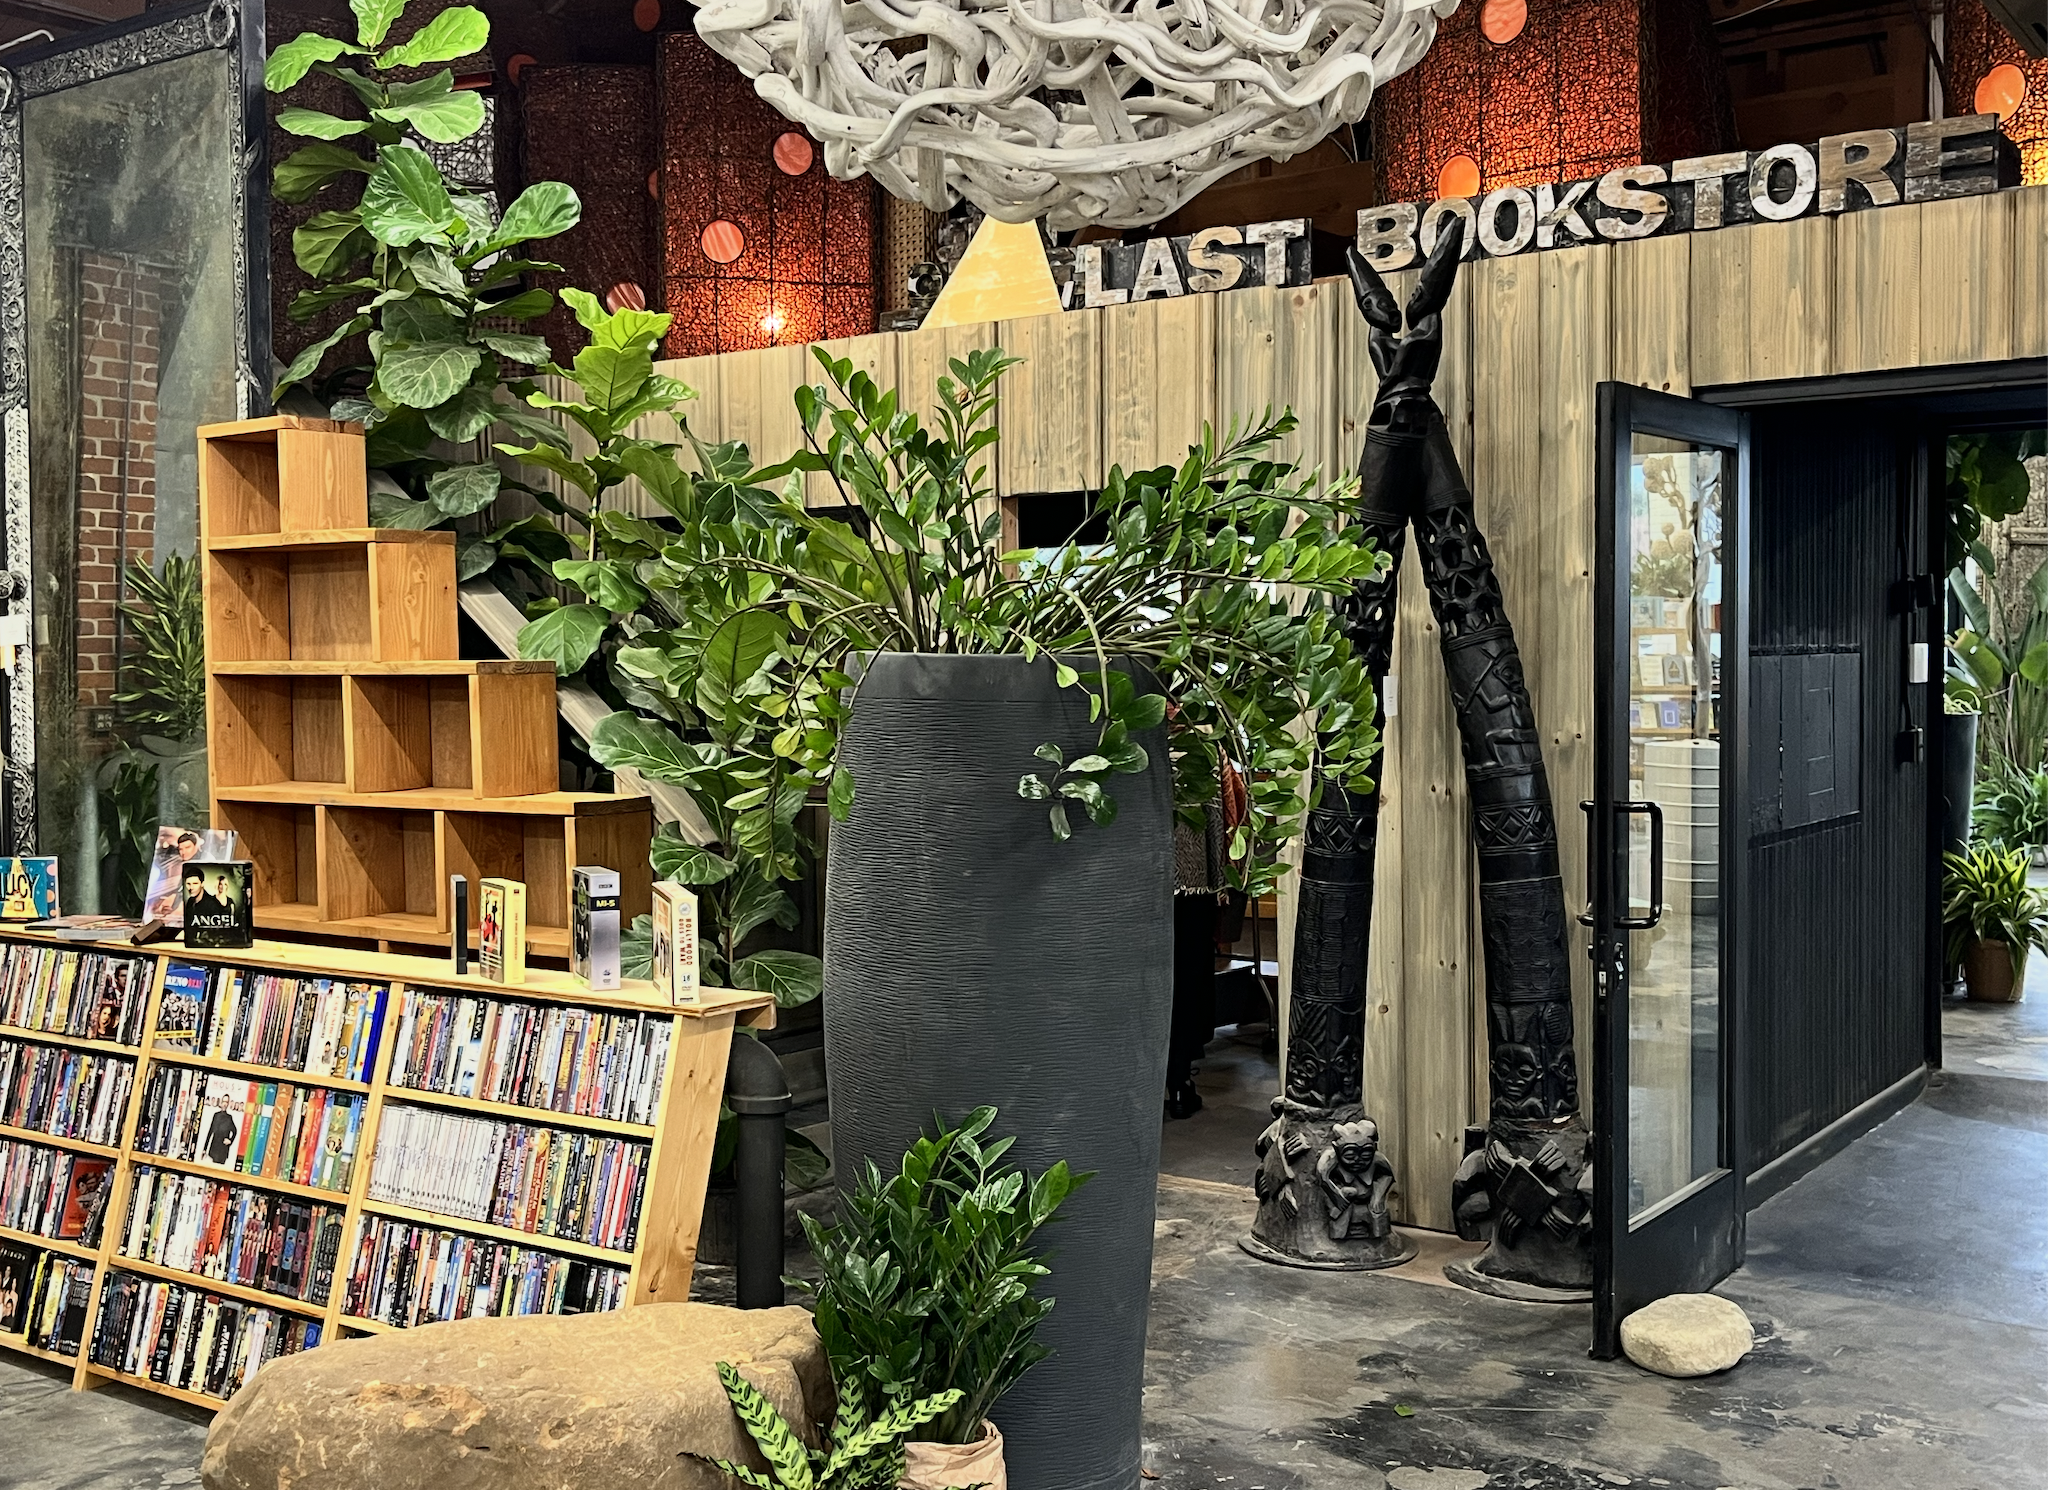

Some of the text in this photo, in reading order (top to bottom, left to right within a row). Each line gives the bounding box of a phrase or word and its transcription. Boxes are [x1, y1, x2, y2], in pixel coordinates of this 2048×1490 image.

[1084, 115, 1998, 308] LAST BOOKSTORE
[191, 914, 239, 928] ANGEL
[213, 1080, 242, 1091] HOUS
